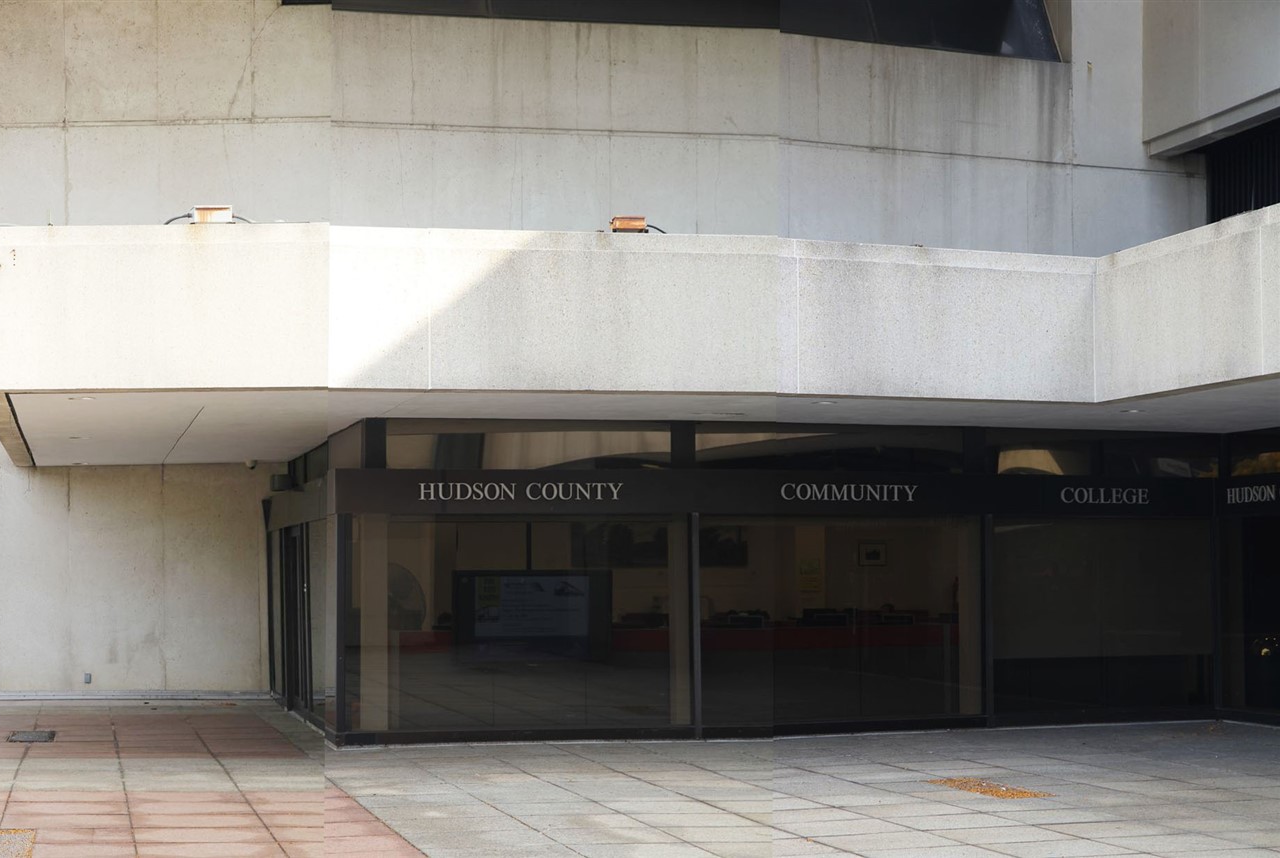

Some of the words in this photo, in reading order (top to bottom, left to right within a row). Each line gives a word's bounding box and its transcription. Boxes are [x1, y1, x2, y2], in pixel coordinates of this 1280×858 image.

[419, 482, 516, 501] HUDSON
[525, 482, 623, 501] COUNTY
[780, 482, 918, 502] COMMUNITY
[1060, 486, 1150, 505] COLLEGE
[1226, 484, 1276, 504] HUDSON
